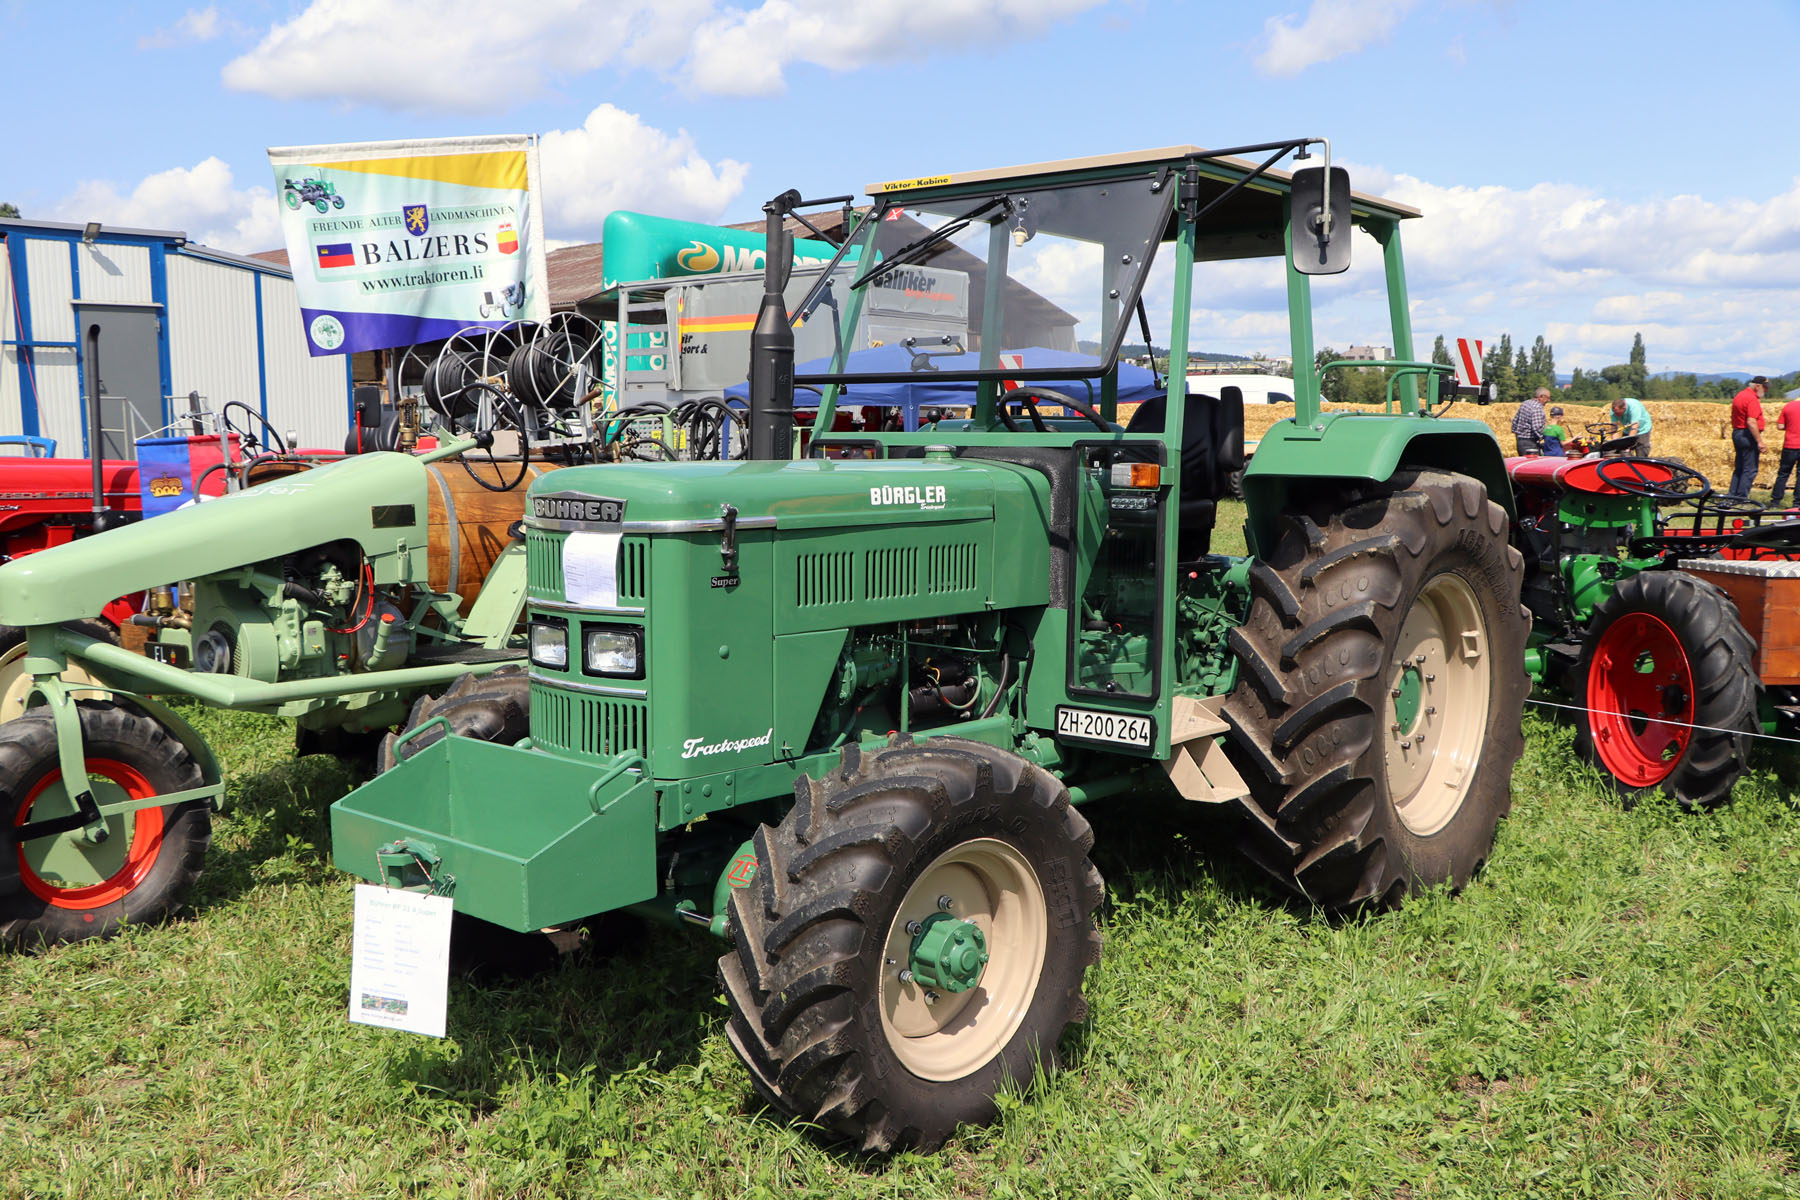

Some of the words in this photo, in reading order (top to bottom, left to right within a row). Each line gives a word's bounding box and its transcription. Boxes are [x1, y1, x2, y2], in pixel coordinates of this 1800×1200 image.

[884, 182, 912, 190] Viktor
[917, 177, 949, 187] Kabine
[312, 220, 364, 232] FREUNDE
[369, 215, 402, 227] ALTER
[430, 205, 515, 222] LANDMASCHINEN
[360, 232, 489, 265] BALZERS
[362, 265, 484, 291] www.traktoren.li
[870, 485, 946, 506] BÜRGLER
[711, 577, 738, 588] Super
[154, 645, 168, 663] FL
[681, 728, 773, 759] Tractospeed
